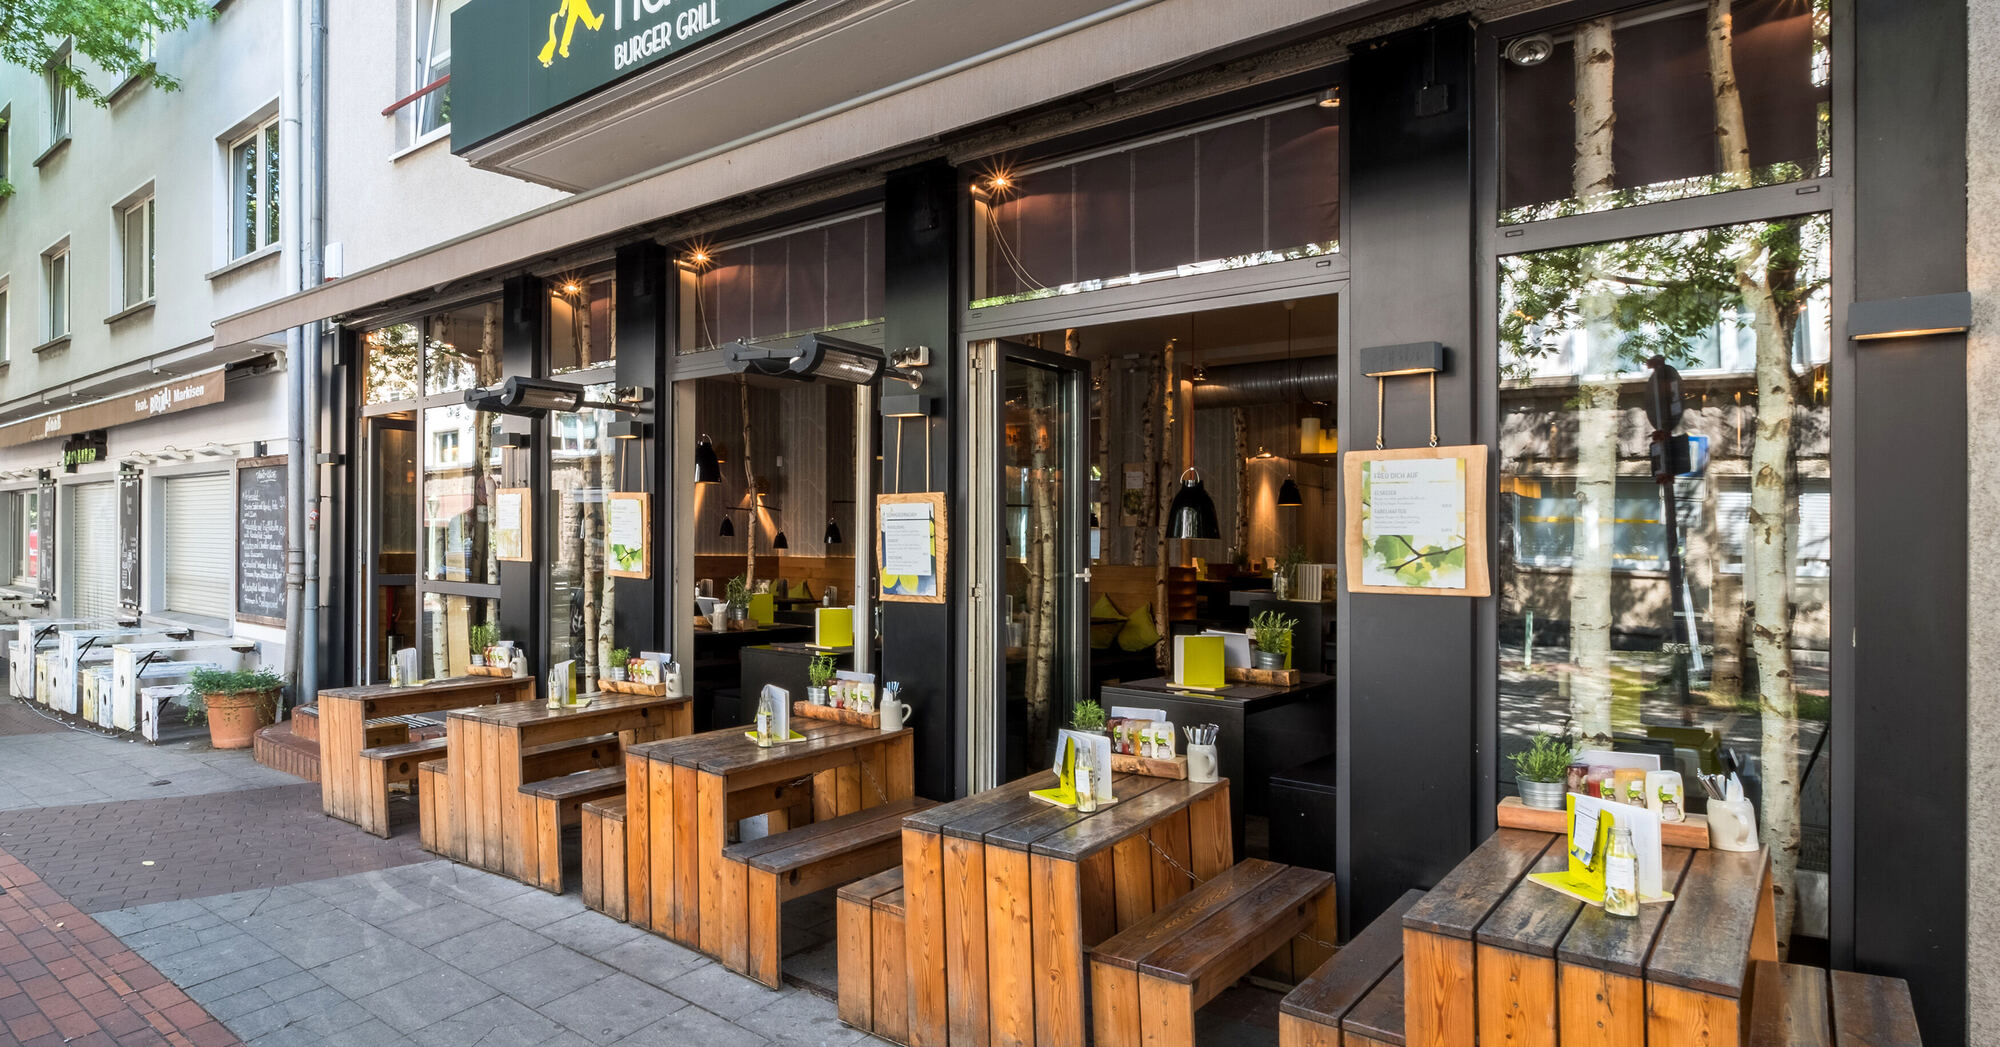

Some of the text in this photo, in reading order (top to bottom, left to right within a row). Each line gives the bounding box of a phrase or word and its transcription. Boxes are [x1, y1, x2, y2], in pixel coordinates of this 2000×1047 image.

[614, 21, 672, 70] BURGER
[676, 0, 720, 40] GRILL
[135, 398, 148, 412] feat.
[173, 385, 205, 402] Markisen
